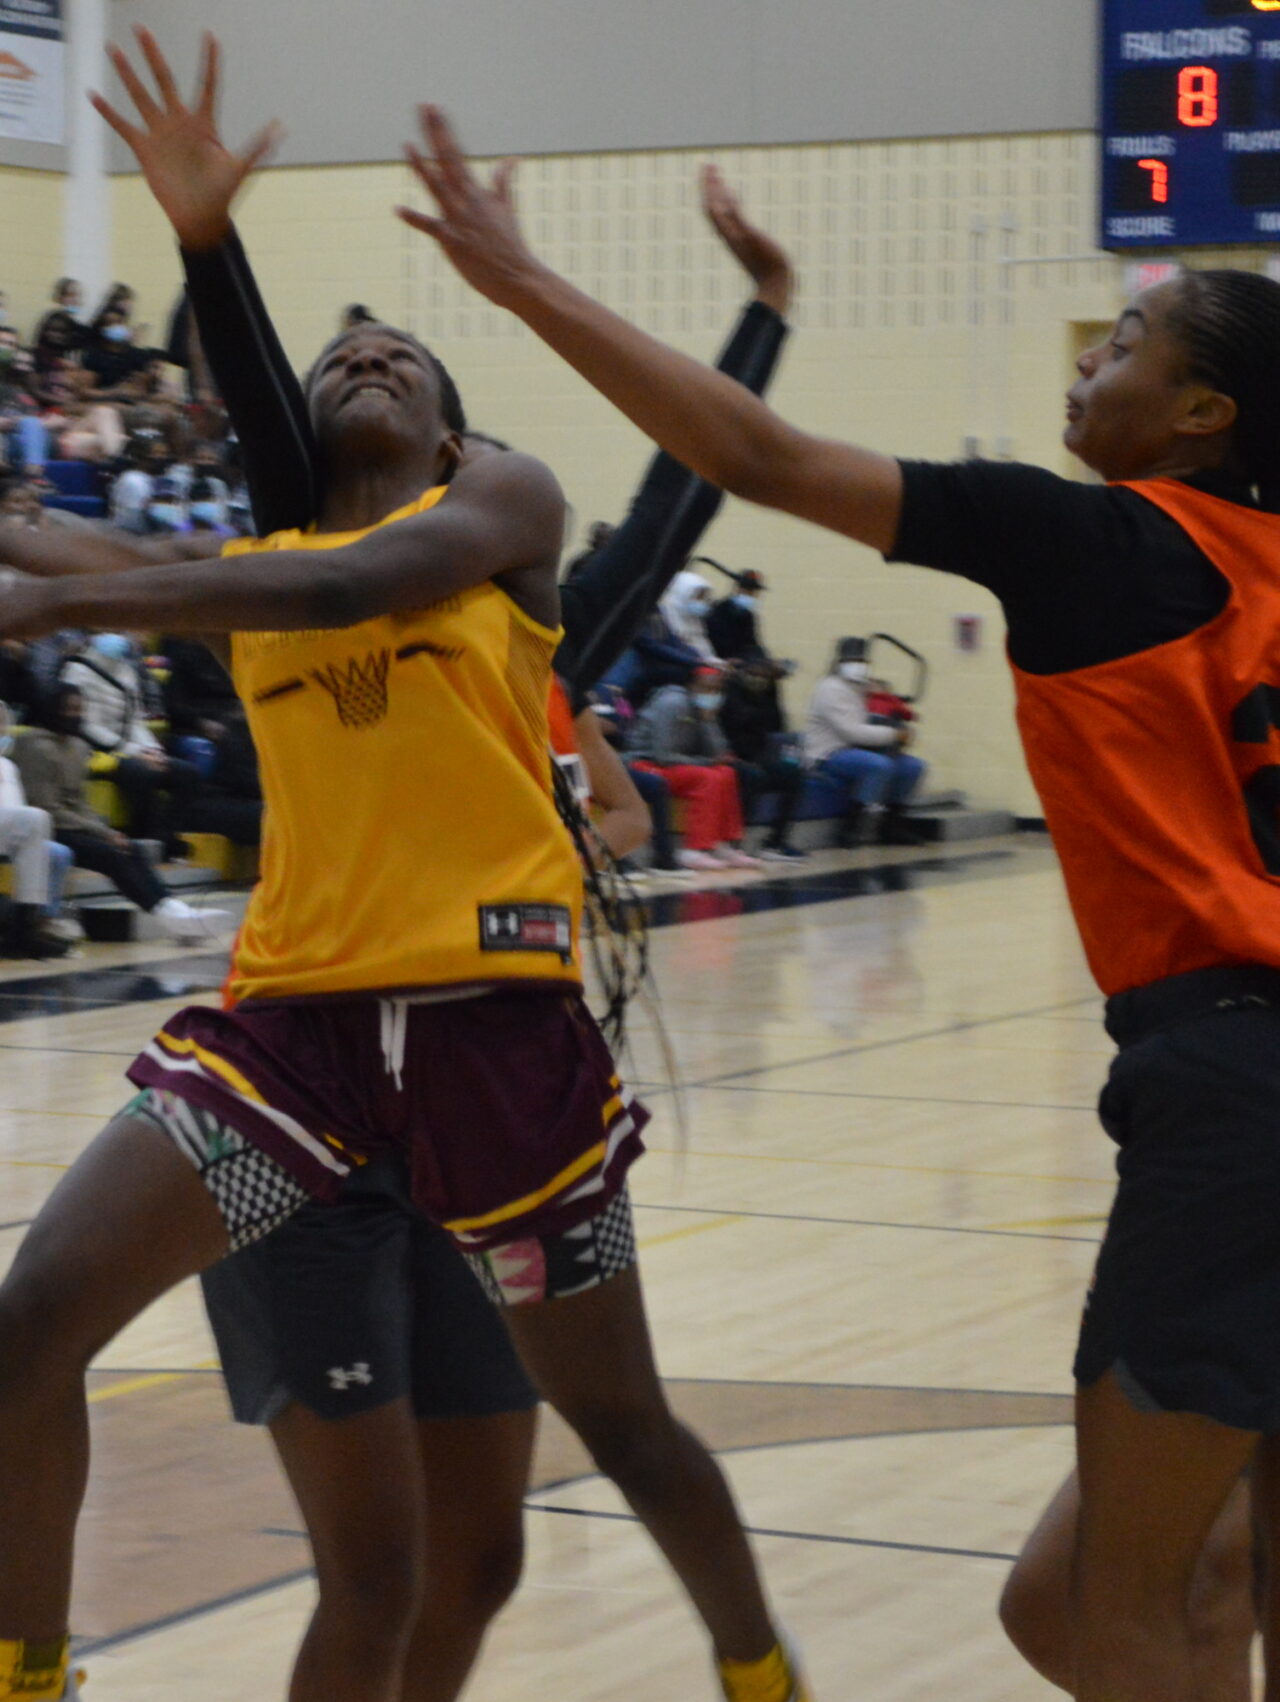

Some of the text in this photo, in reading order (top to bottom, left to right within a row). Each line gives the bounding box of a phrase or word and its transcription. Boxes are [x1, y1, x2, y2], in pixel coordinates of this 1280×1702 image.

[1121, 26, 1252, 60] FALCONS
[1178, 65, 1218, 127] 8
[1137, 159, 1168, 203] 7
[1106, 216, 1176, 238] SCORE
